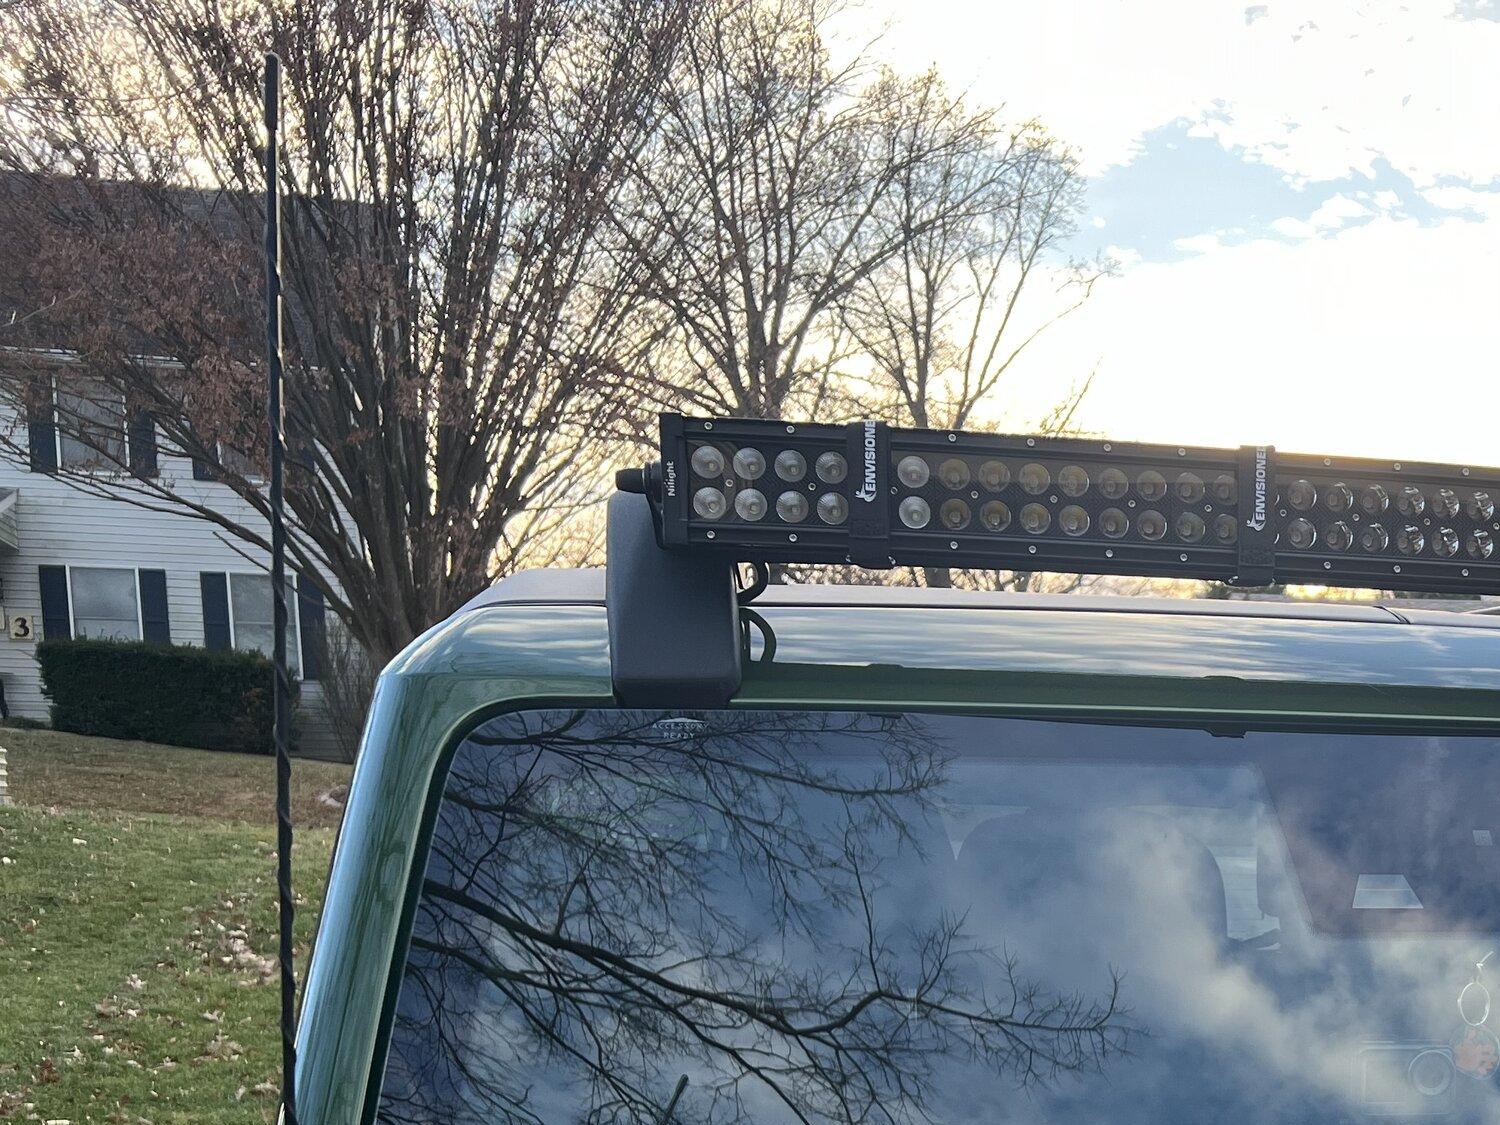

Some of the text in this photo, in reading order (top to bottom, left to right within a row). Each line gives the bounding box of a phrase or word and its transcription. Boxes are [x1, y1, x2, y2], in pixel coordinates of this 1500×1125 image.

[663, 460, 677, 497] Nilight
[14, 617, 30, 637] 3
[651, 722, 709, 730] ACCESSORY
